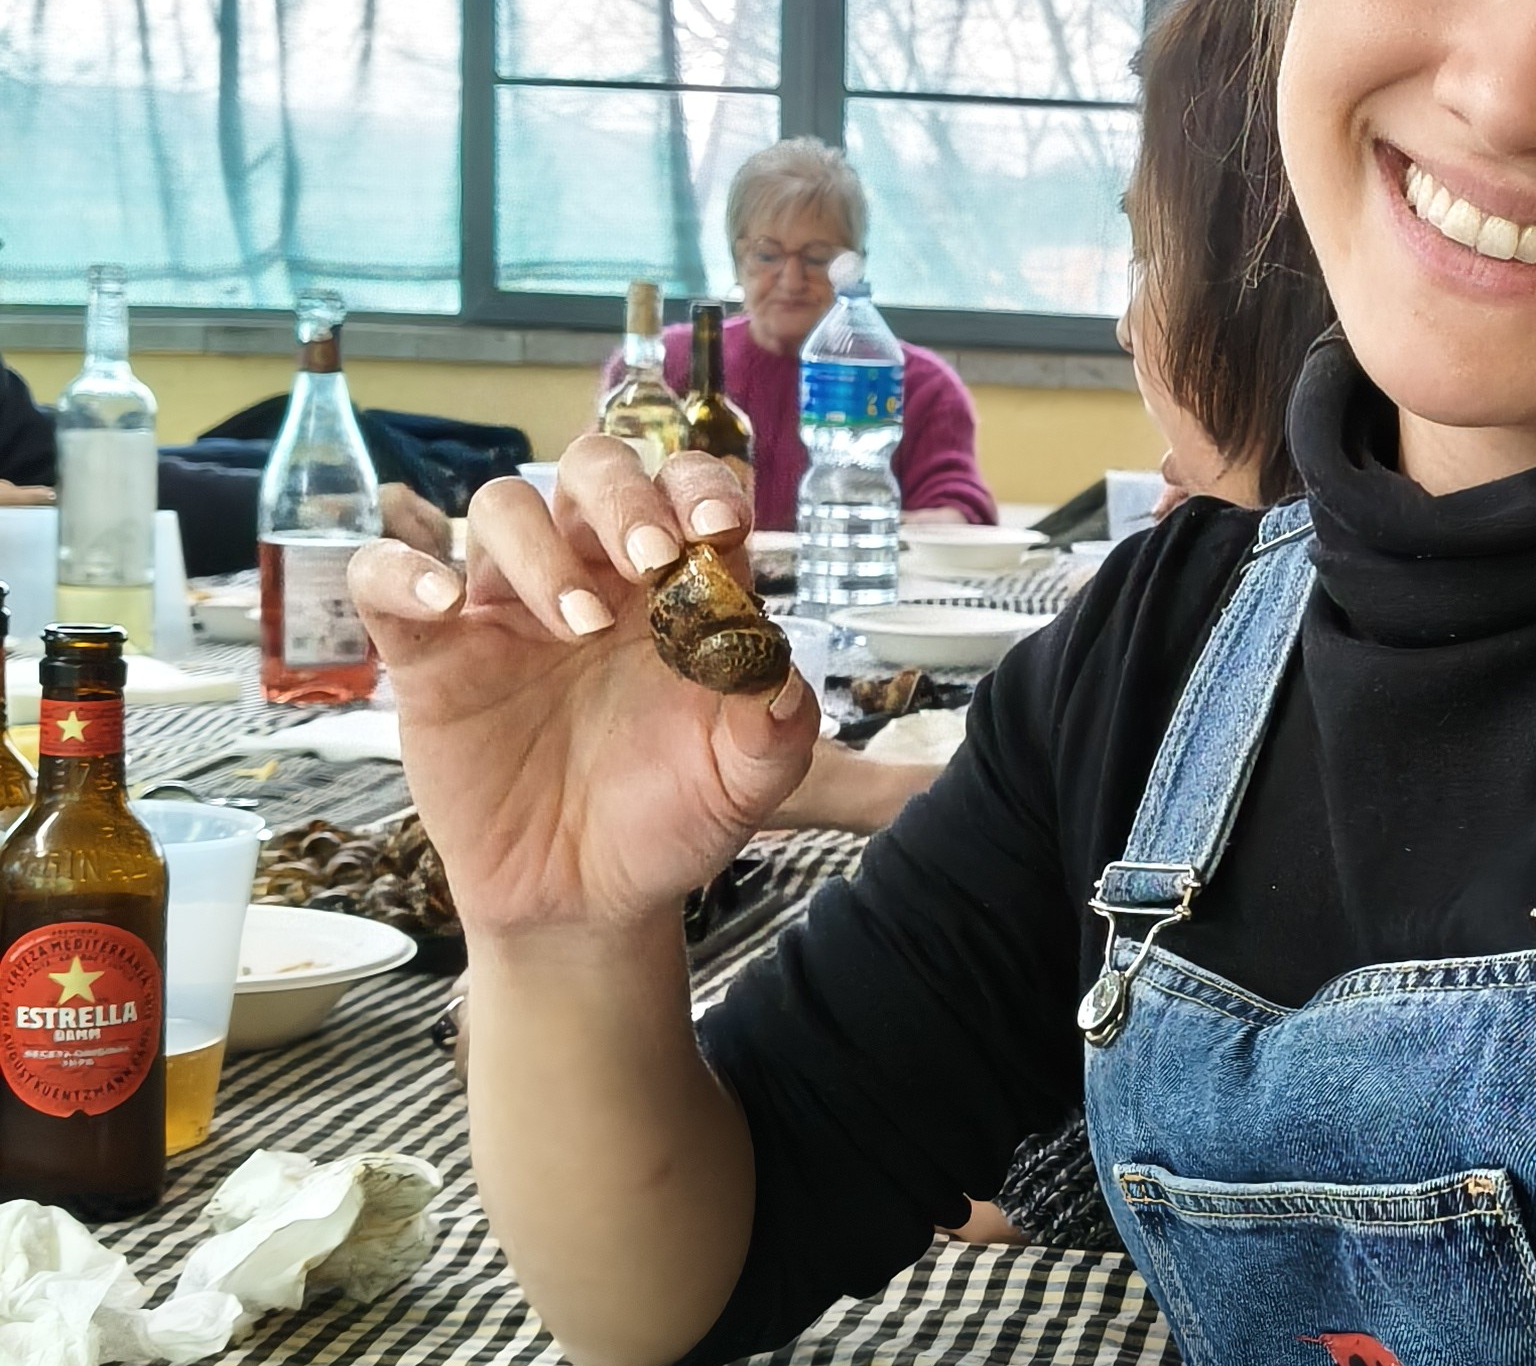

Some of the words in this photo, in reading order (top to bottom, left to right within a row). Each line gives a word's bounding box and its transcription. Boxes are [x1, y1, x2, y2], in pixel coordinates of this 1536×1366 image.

[16, 1001, 138, 1029] ESTRELLA
[53, 1028, 102, 1042] DAMM
[4, 1033, 34, 1085] AUGUST
